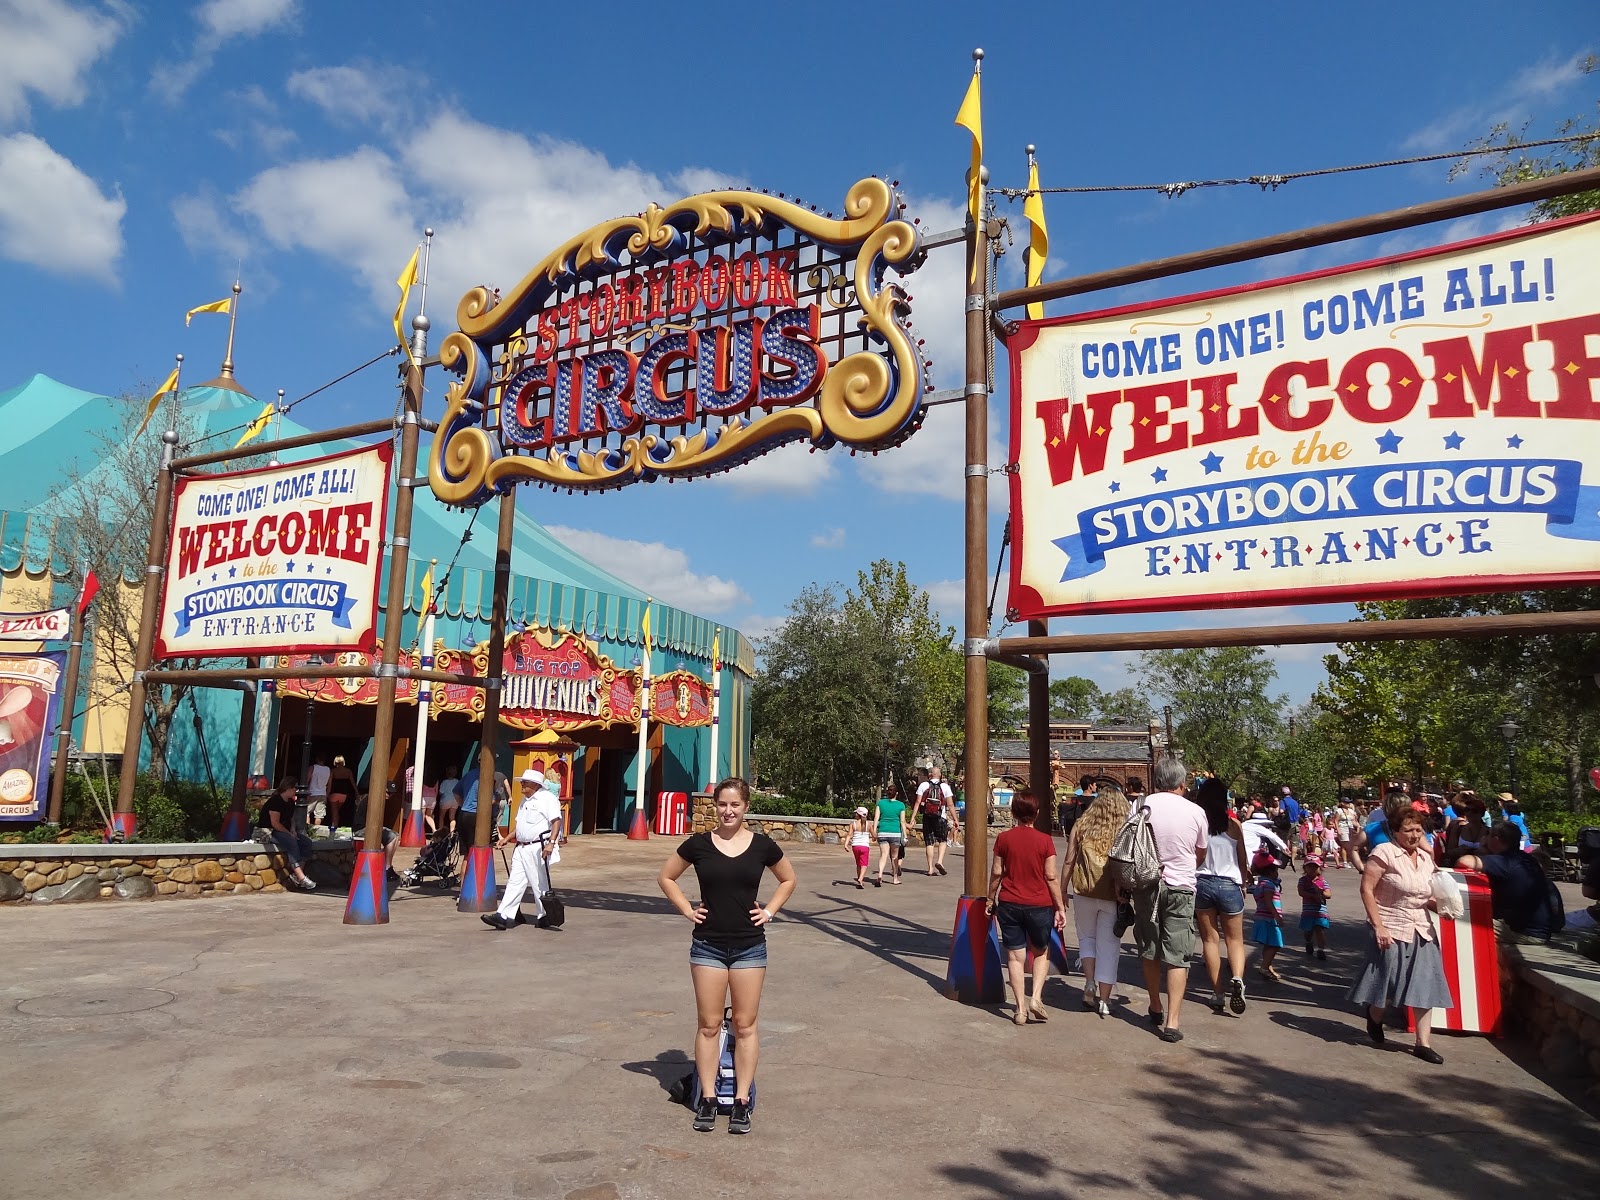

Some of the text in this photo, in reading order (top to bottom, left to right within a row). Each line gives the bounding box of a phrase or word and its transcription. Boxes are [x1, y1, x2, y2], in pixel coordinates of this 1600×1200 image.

[535, 250, 799, 362] STORYBOOK
[1082, 257, 1555, 379] COME ONE! COME ALL!
[501, 303, 829, 450] CIRCUS
[1036, 313, 1600, 486] WELCOME
[1245, 430, 1352, 471] to the
[197, 469, 356, 517] COME ONE! COME ALL!
[1093, 465, 1557, 544] STORYBOOK CIRCUS
[178, 501, 373, 580] WELCOME
[242, 557, 278, 577] to the
[188, 582, 340, 617] STORYBOOK CIRCUS
[514, 653, 581, 676] BIG TOP
[0, 806, 30, 814] CIRCUS
